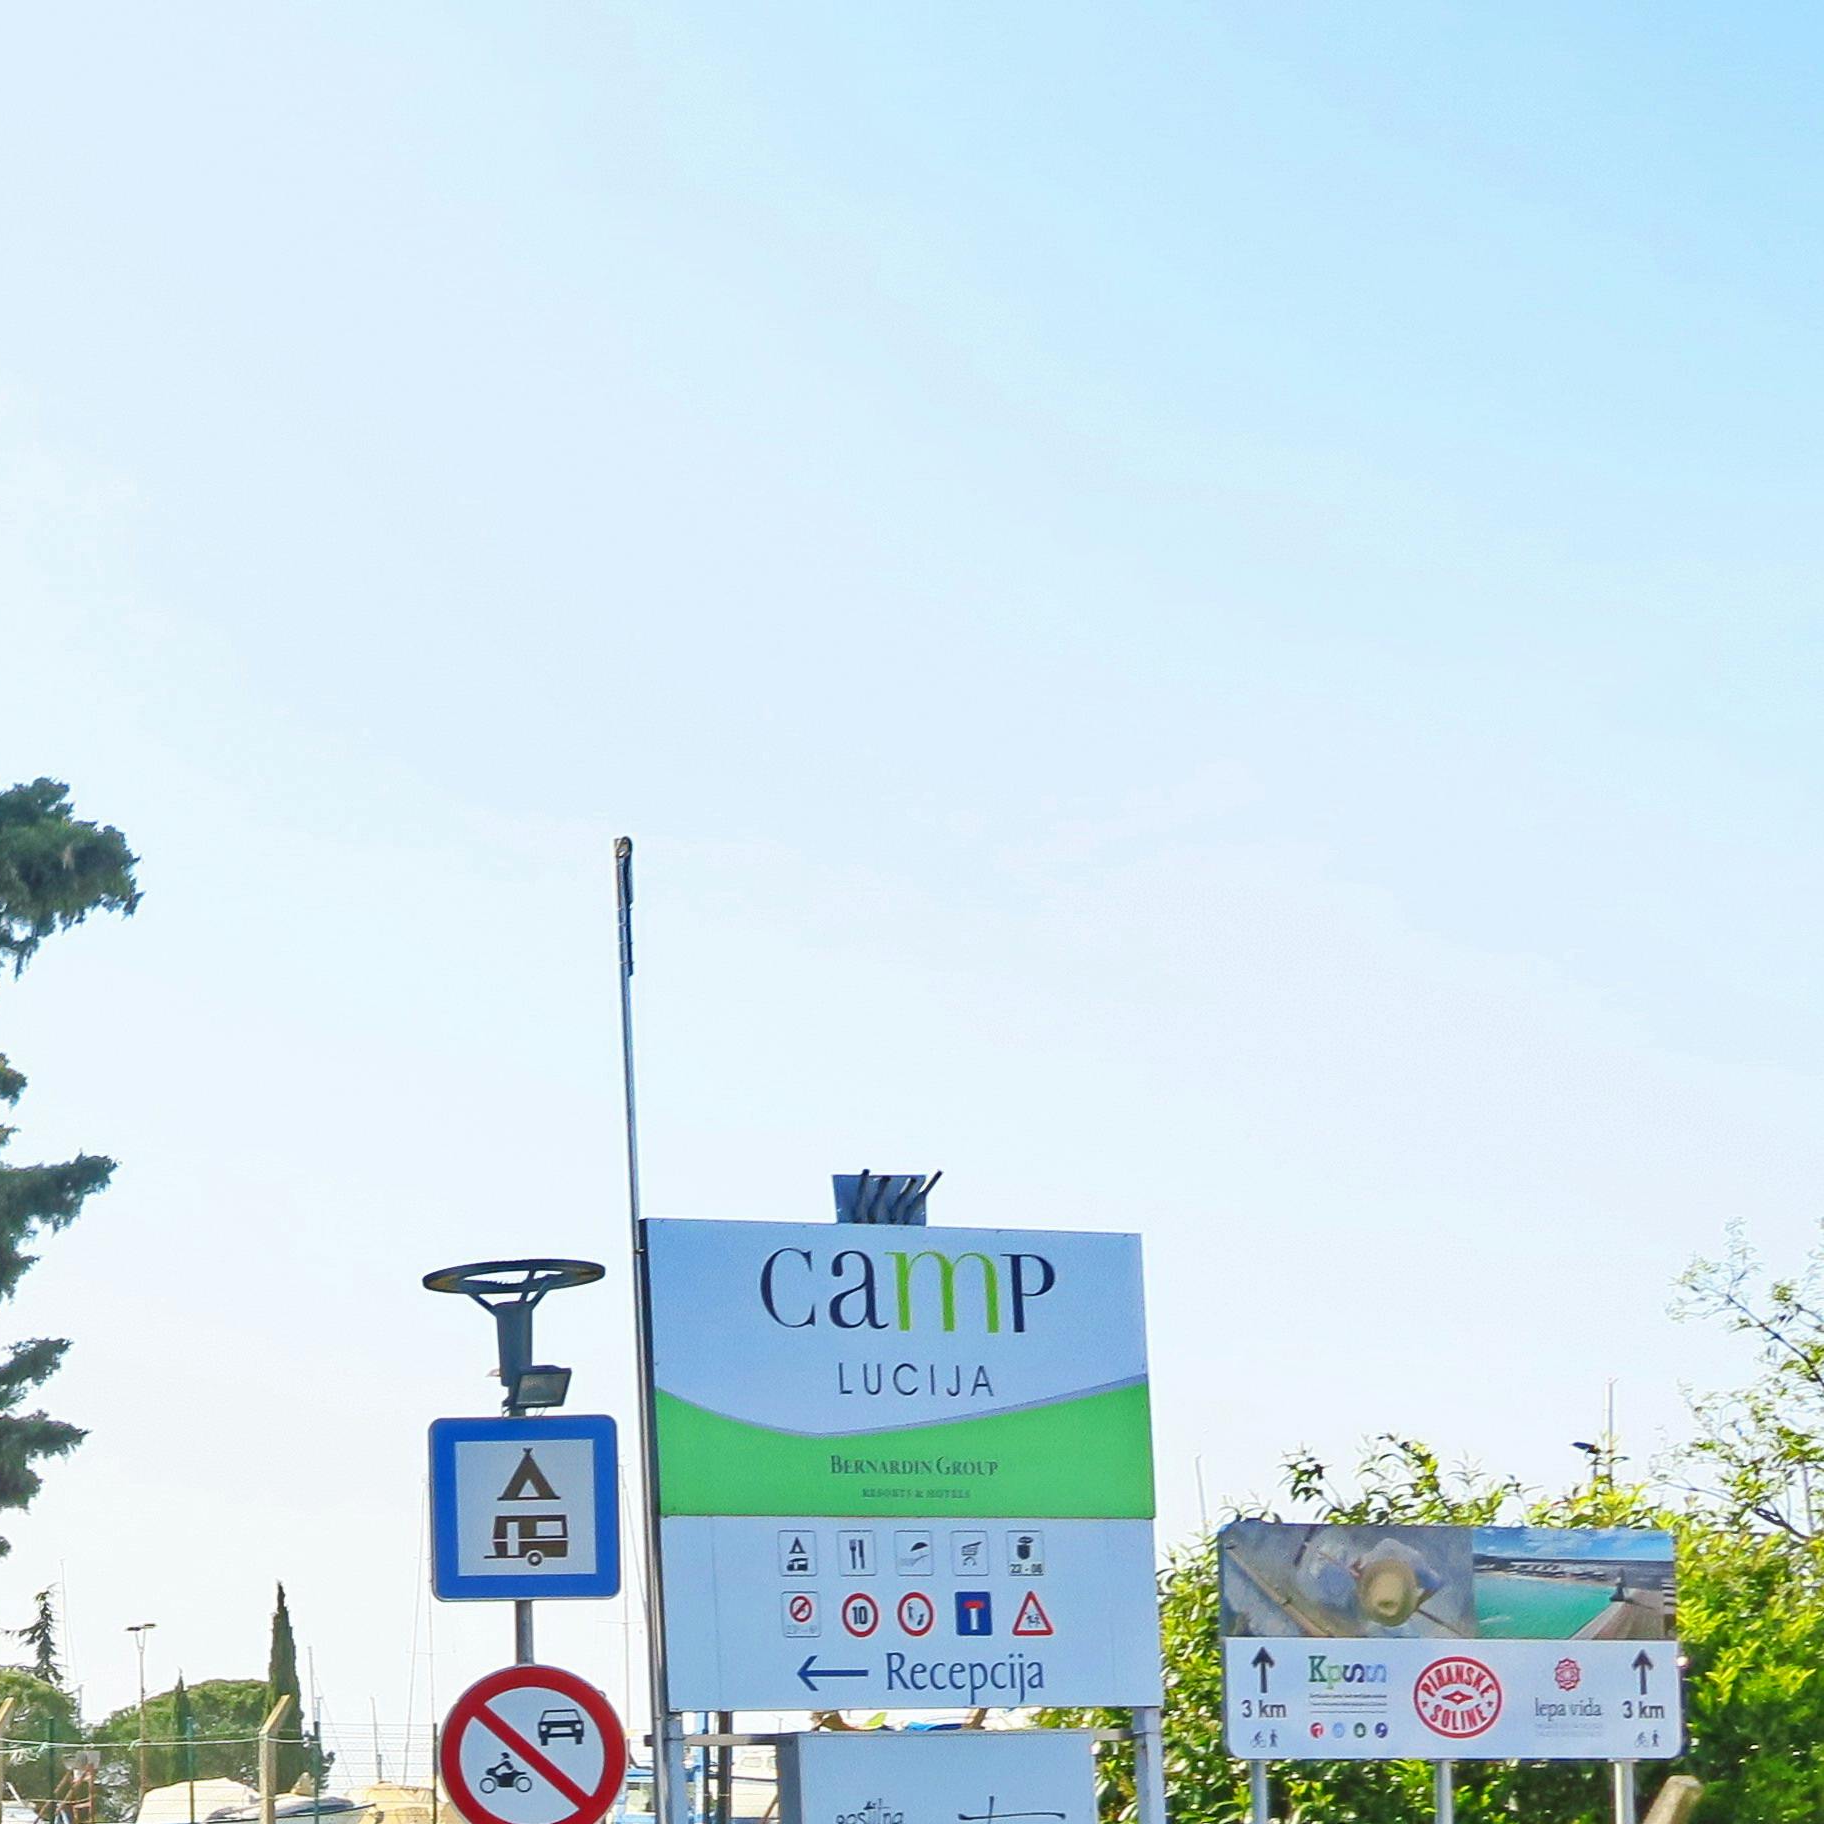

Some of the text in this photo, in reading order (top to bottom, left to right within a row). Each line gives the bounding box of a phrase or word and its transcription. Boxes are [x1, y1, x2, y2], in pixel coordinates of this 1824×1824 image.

[837, 1361, 994, 1397] LUCIJA
[852, 1605, 868, 1625] 10
[885, 1651, 1044, 1705] Recepcija
[1422, 1663, 1495, 1698] PIRANSKE
[1242, 1700, 1253, 1718] 3
[1258, 1699, 1287, 1718] km
[1429, 1703, 1489, 1731] SOLINE
[1534, 1696, 1604, 1722] lepa vida
[1622, 1700, 1665, 1719] 3 km
